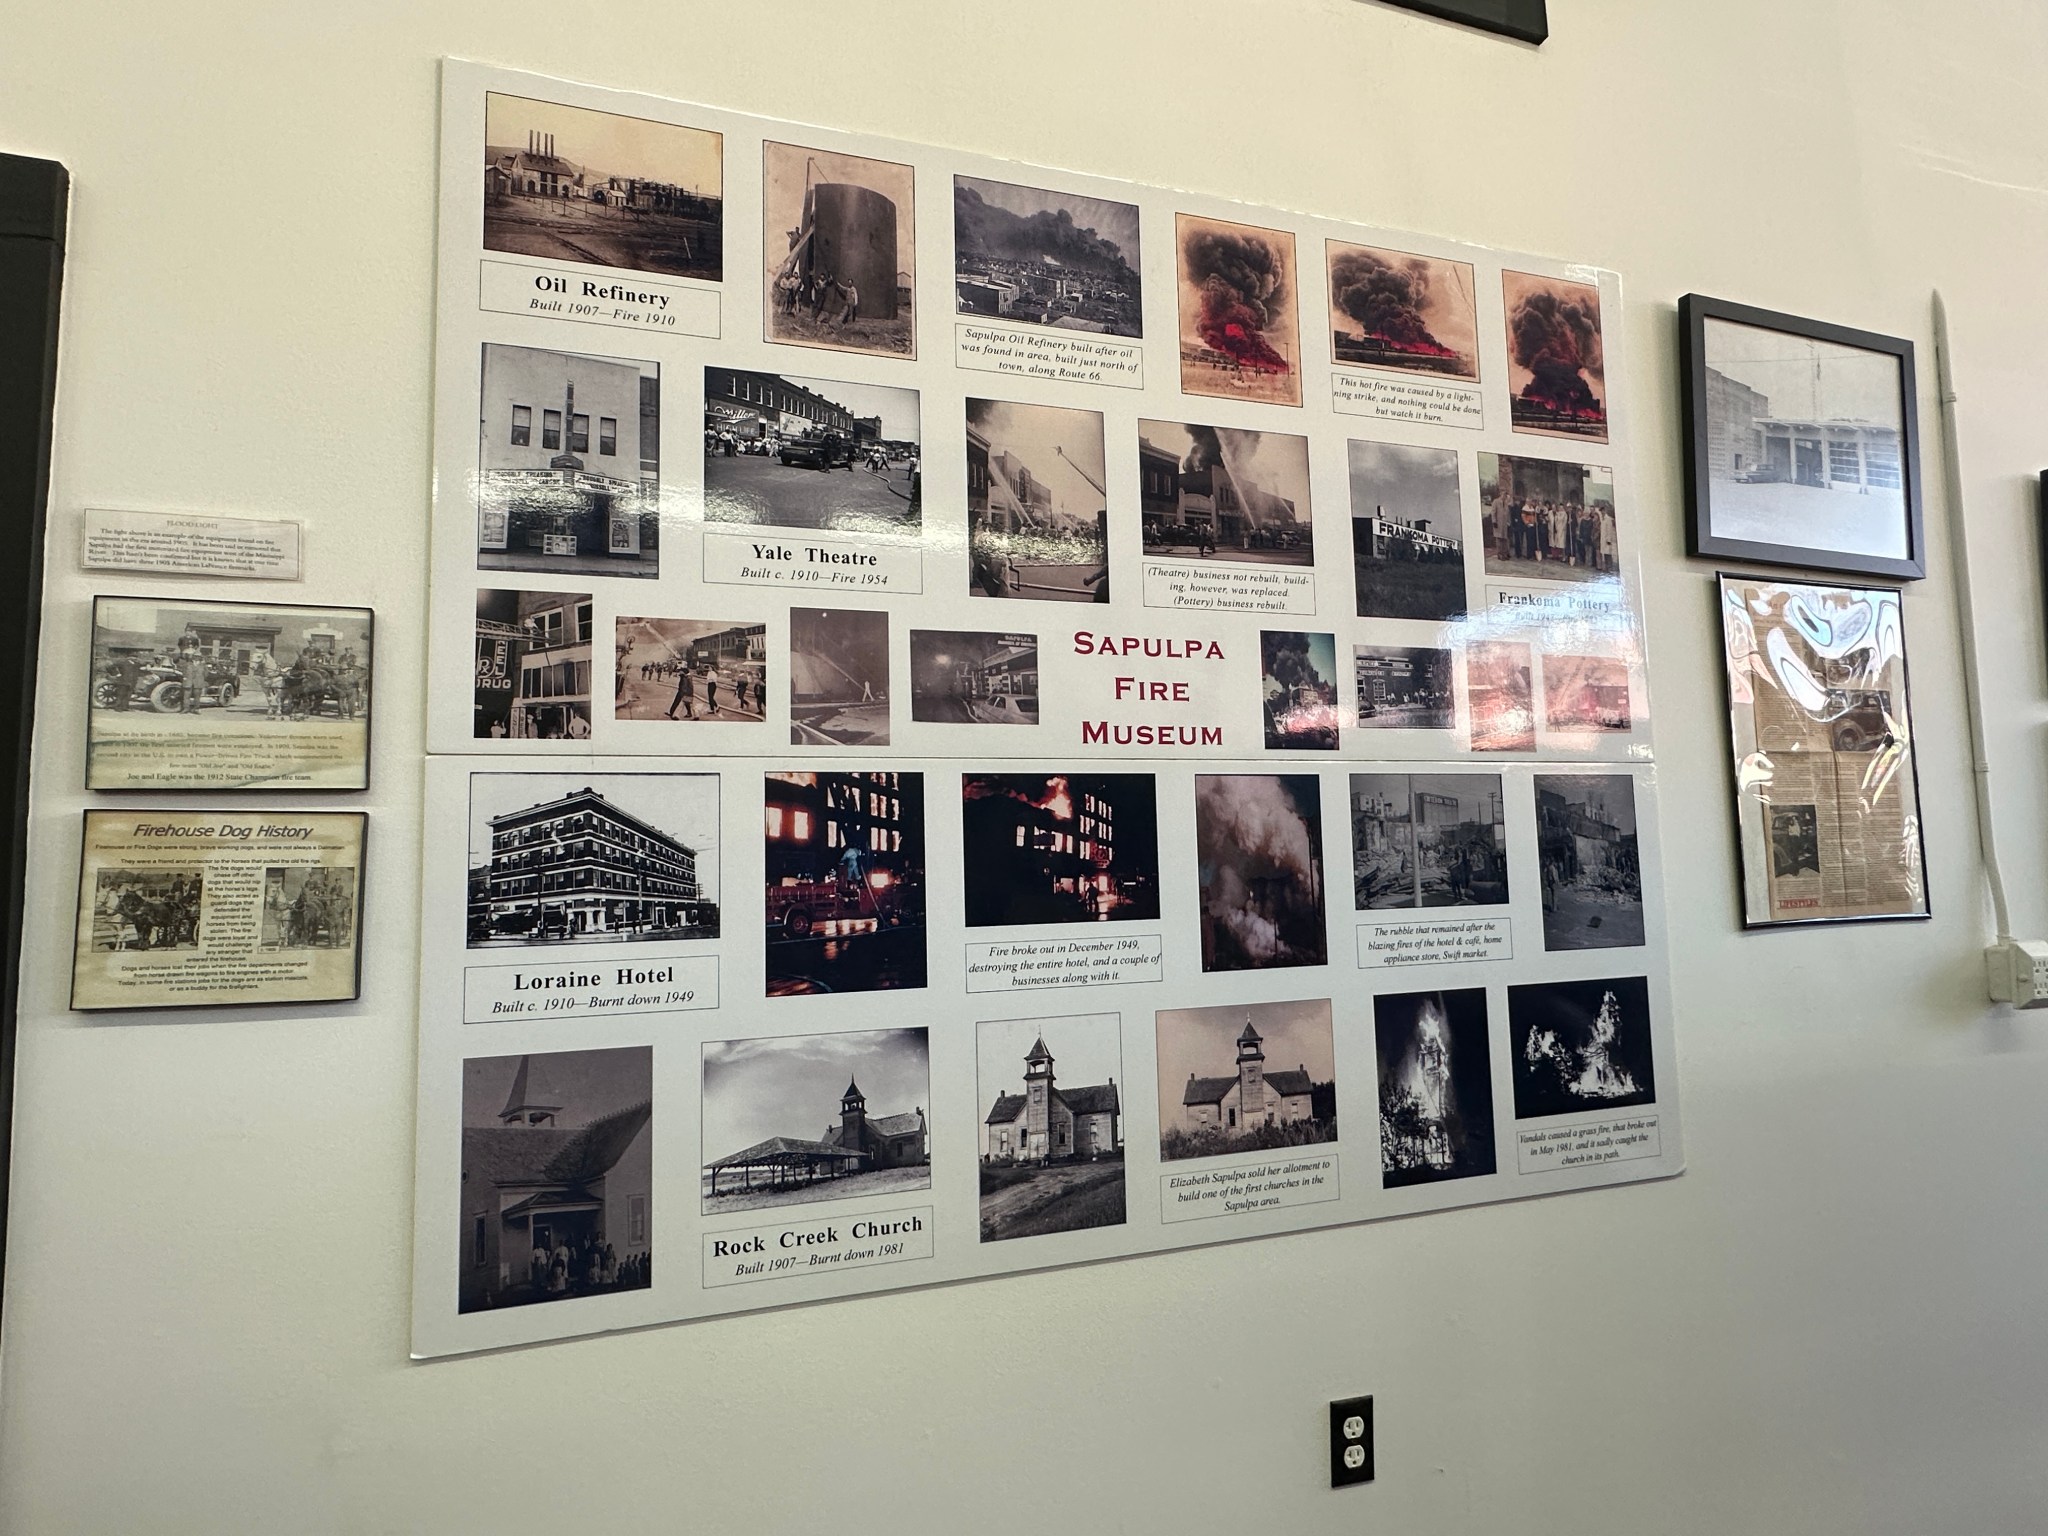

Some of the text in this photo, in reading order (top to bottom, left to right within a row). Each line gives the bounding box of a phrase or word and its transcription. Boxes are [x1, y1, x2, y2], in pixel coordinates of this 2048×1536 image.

[535, 275, 670, 310] Oil Refinery
[529, 298, 676, 326] Built 1907—Fire 1910
[965, 328, 1133, 357] Sapulpa Oil Refinery built after oil
[961, 344, 980, 352] was
[981, 344, 1012, 356] found
[1014, 349, 1024, 357] in
[1055, 353, 1077, 364] built
[1078, 357, 1097, 367] just
[1100, 361, 1125, 370] north
[1127, 363, 1138, 373] of
[1028, 364, 1056, 377] along
[1058, 367, 1086, 379] Route
[1340, 377, 1357, 387] This
[1359, 379, 1372, 389] hot
[1372, 381, 1388, 392] fire
[1389, 385, 1405, 393] was
[1407, 388, 1434, 397] caused
[1435, 389, 1445, 400] by
[1453, 391, 1474, 402] light-
[1333, 390, 1352, 400] ning
[1380, 395, 1396, 404] and
[1397, 398, 1427, 409] nothing
[1429, 402, 1451, 411] could
[1451, 403, 1461, 412] be
[1462, 405, 1481, 414] done
[1375, 405, 1388, 415] but
[1390, 409, 1413, 418] watch
[1415, 411, 1421, 419] it
[1379, 522, 1428, 542] FRANKOMA
[752, 544, 877, 566] Yale Theatre
[740, 566, 888, 585] Built c. 1910—Fire 1954
[1147, 566, 1190, 580] (Theatre)
[1192, 569, 1230, 580] business
[1283, 575, 1309, 584] build-
[1173, 595, 1213, 608] (Pottery)
[1216, 597, 1254, 608] business
[1231, 587, 1248, 595] was
[1499, 592, 1610, 613] Frankoma Pottery
[1074, 631, 1225, 659] SAPULPA
[1115, 677, 1189, 702] FIRE
[1082, 721, 1223, 745] MUSEUM
[157, 773, 176, 781] Eagle
[133, 824, 314, 840] Firehouse Dog History
[1374, 922, 1495, 937] The rubble that remained after the
[988, 939, 1139, 957] Fire broke out in December 1949,
[1367, 940, 1395, 951] blazing
[1395, 939, 1413, 951] fires
[1414, 938, 1424, 950] of
[1423, 938, 1435, 947] the
[1436, 936, 1455, 947] hotel
[1455, 936, 1463, 946] &
[1483, 935, 1502, 943] home
[968, 962, 1018, 974] destroying
[1019, 959, 1034, 970] the
[1036, 960, 1063, 969] entire
[1065, 956, 1089, 967] hotel,
[1092, 955, 1110, 966] and
[1119, 953, 1149, 966] couple
[1151, 953, 1162, 965] of
[1383, 953, 1420, 965] appliance
[1442, 949, 1461, 961] Swift
[513, 966, 673, 990] Loraine Hotel
[1011, 970, 1120, 986] businesses along with it.
[491, 990, 694, 1013] Built c. 1910—Burnt down 1949
[1169, 1161, 1330, 1188] Elizabeth Sapulpa sold her allotment to
[1177, 1174, 1324, 1202] build one of the first churches in the
[1223, 1198, 1259, 1212] Sapulpa
[713, 1216, 922, 1257] Rock Creek Church
[734, 1242, 904, 1276] Built 1907—Burnt down 1981
